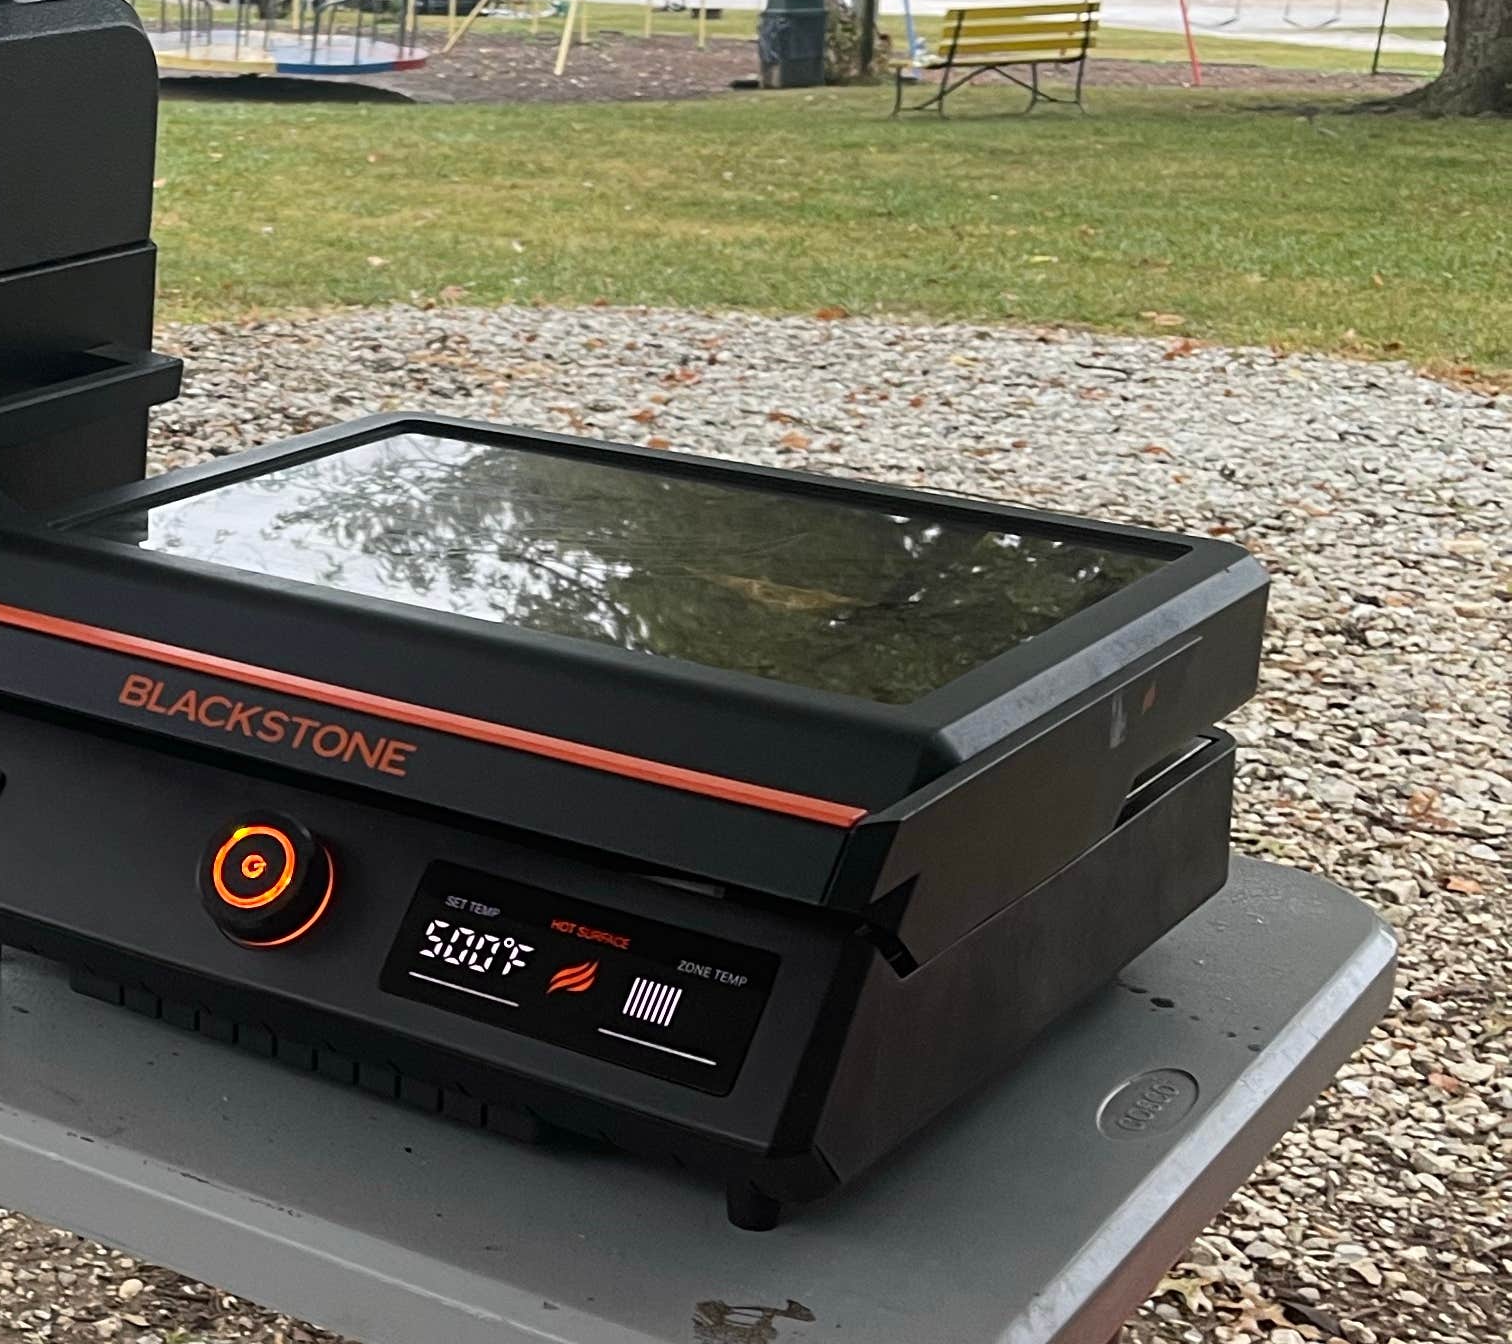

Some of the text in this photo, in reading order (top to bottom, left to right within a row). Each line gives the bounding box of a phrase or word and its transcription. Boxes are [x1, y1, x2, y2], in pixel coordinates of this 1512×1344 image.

[118, 673, 418, 777] BLACKSTONE
[445, 896, 502, 917] SET TEMP
[550, 919, 631, 950] HOT SURFACE
[677, 959, 749, 987] ZONE TEMP
